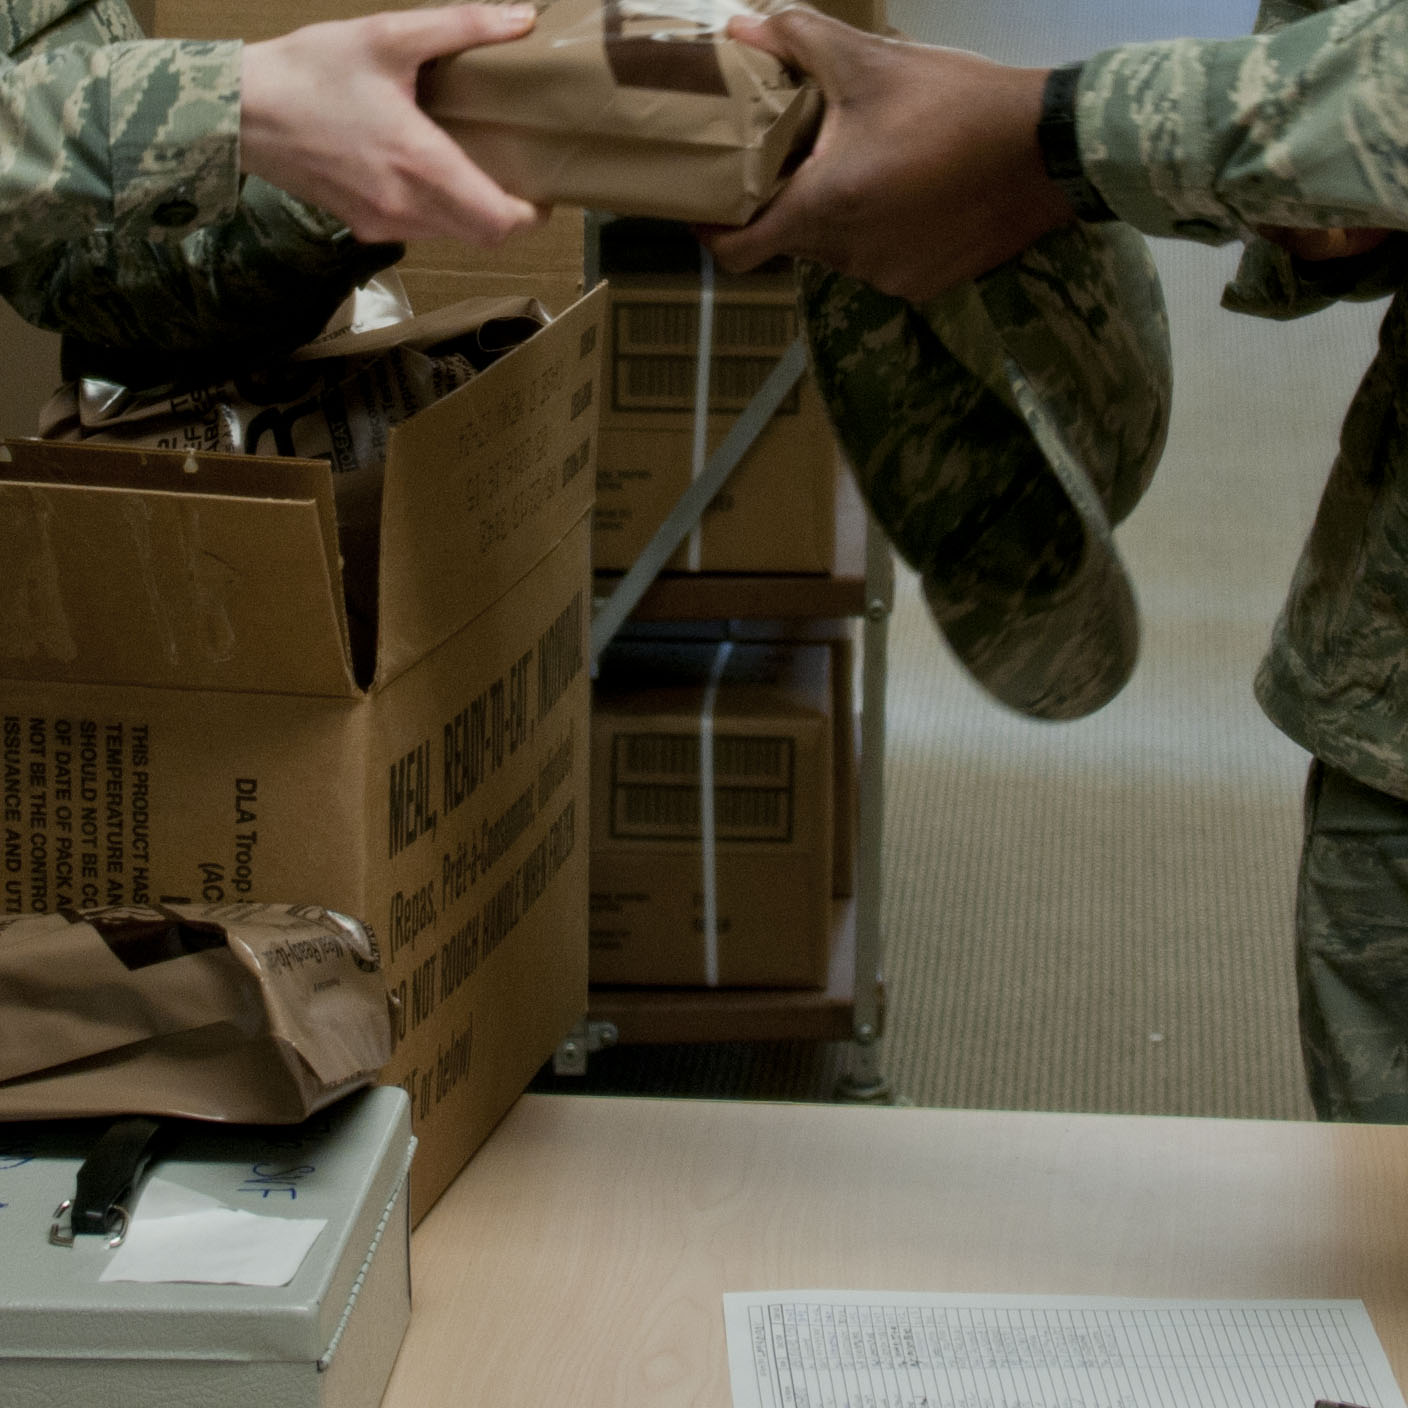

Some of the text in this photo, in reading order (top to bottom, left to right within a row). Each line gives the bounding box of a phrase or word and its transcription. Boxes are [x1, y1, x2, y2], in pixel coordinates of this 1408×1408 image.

[29, 717, 46, 757] NOT
[54, 719, 72, 746] OF
[3, 715, 21, 822] ISSUANCE
[29, 761, 47, 787] BE
[54, 751, 72, 801] DATE
[80, 720, 98, 802] SHOULD
[29, 791, 47, 829] THE
[55, 806, 72, 833] OF
[105, 722, 123, 873] TEMPERATURE
[131, 724, 150, 904] THIS PRODUCT HAS
[235, 778, 257, 824] DLA
[389, 739, 438, 859] MEAL,
[4, 828, 22, 873] AND
[81, 807, 98, 848] NOT
[55, 837, 73, 889] PACK
[81, 853, 98, 878] BE
[230, 831, 257, 893] Troop
[412, 954, 436, 1030] NOT
[441, 911, 480, 1004] ROUGH
